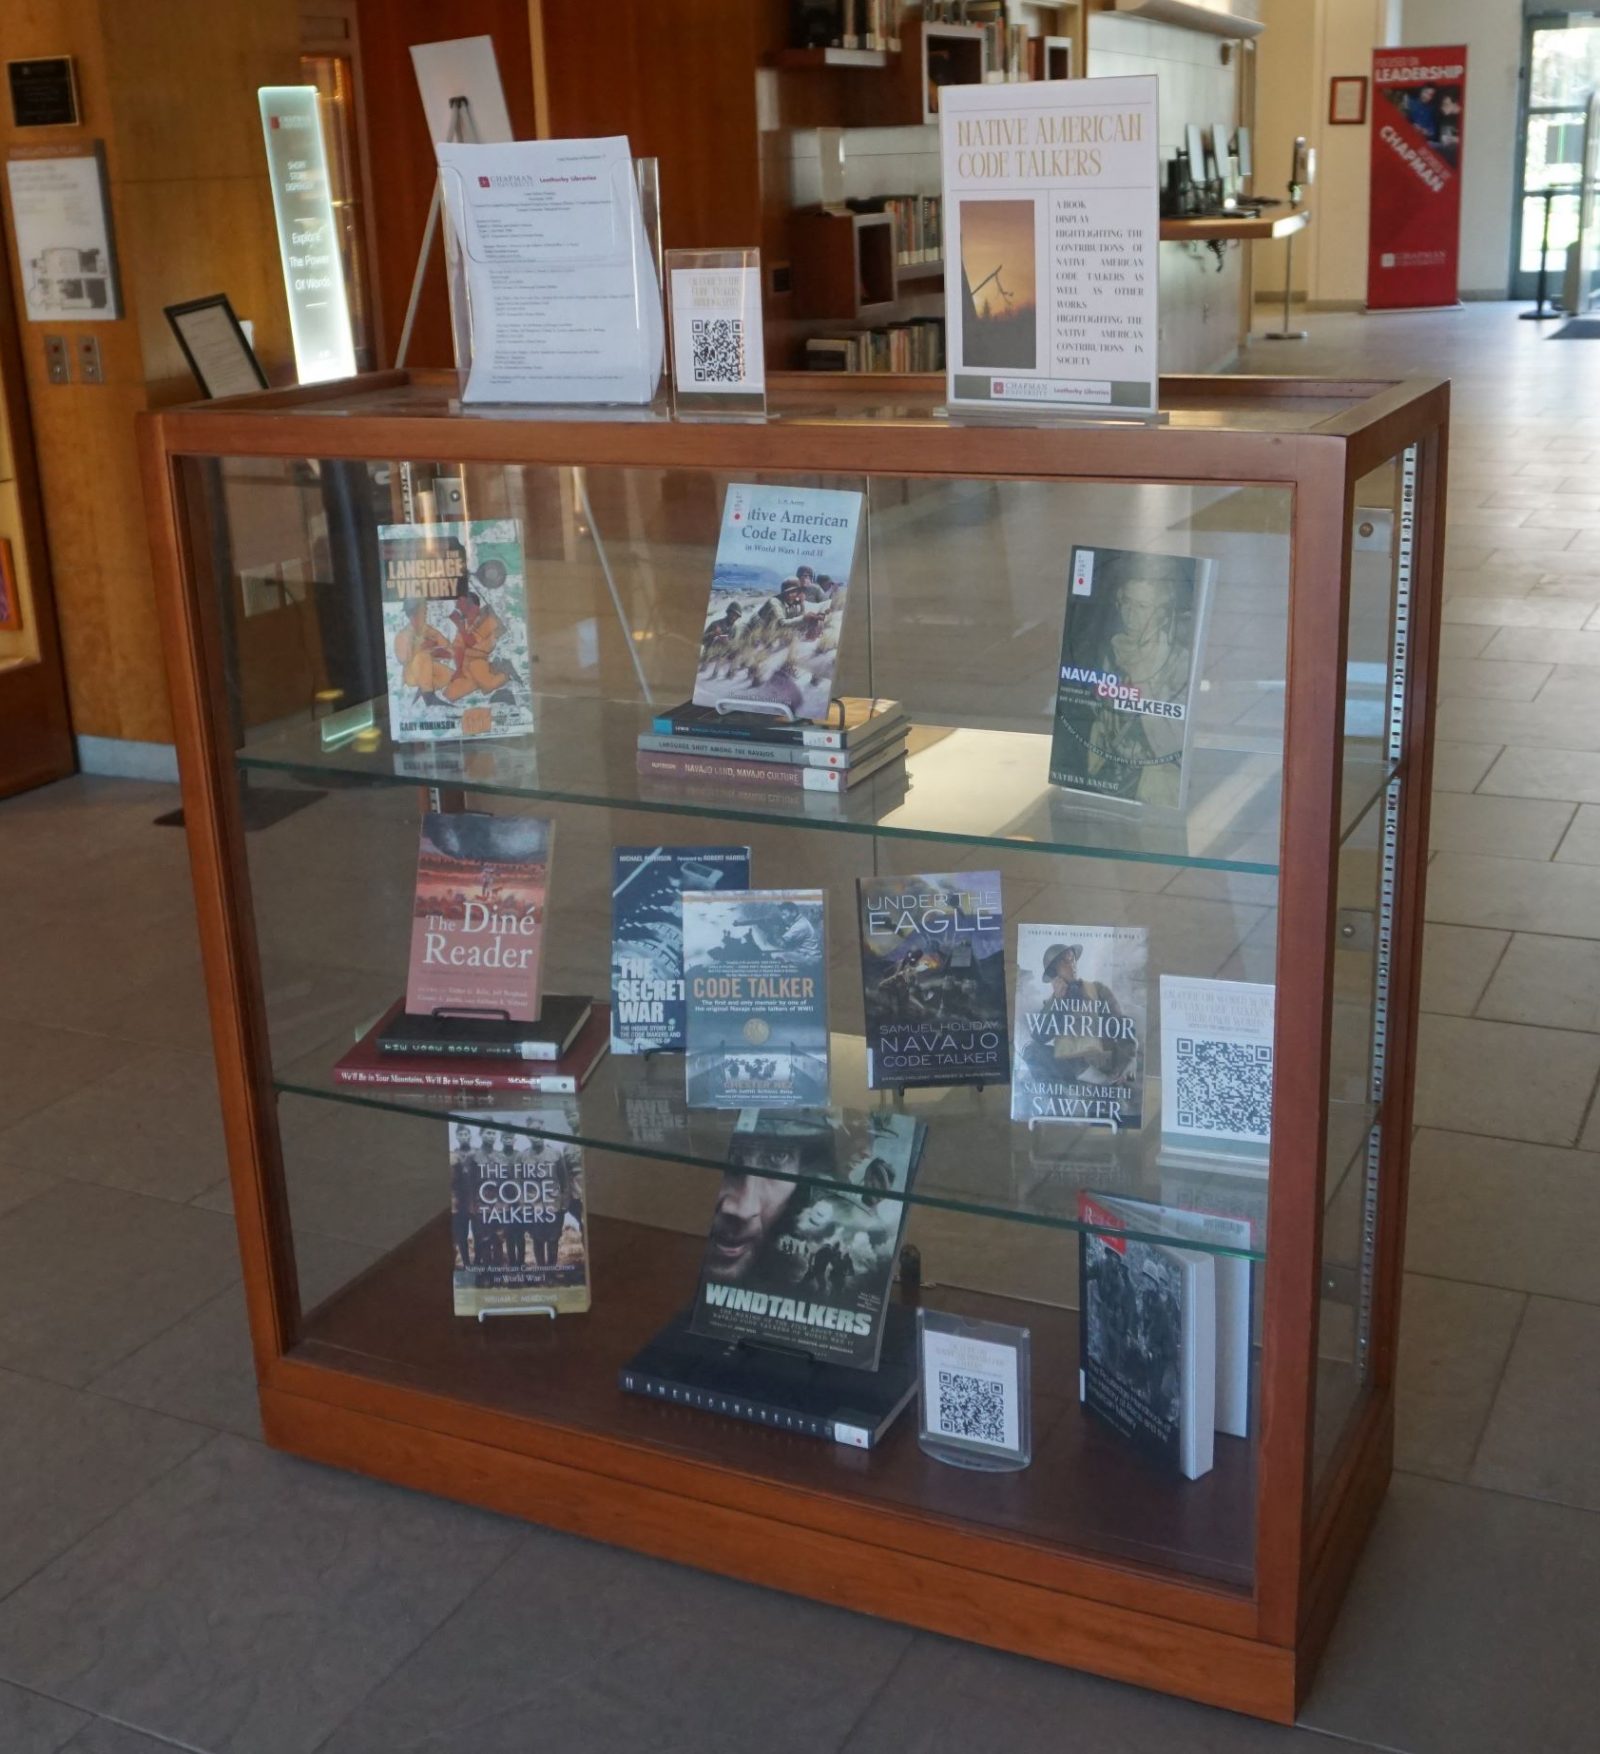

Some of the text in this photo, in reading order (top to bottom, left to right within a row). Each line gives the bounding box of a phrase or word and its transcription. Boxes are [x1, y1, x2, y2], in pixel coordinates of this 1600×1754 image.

[1375, 65, 1464, 82] LEADERSHIP
[958, 113, 1142, 146] NATIVE AMERICAN
[958, 149, 1103, 178] CODE TALKERS
[1380, 126, 1443, 192] CHAPMAN
[292, 232, 321, 246] Explore
[1128, 229, 1142, 238] THE
[1056, 243, 1143, 252] CONTRIBUTIONS OF
[289, 254, 330, 266] The Power
[1057, 258, 1144, 267] NATIVE AMERICAN
[295, 278, 331, 290] Of Words
[1056, 272, 1144, 281] CODE TALKERS AS
[1057, 286, 1144, 296] WELL AS OTHER
[1057, 300, 1087, 309] WORKS
[1128, 316, 1142, 325] THE
[1057, 329, 1144, 339] NATIVE AMERICAN
[1057, 343, 1125, 352] CONTRIBUTIONS
[1057, 356, 1090, 365] SOCIETY
[780, 510, 849, 529] American
[741, 525, 833, 546] Code Talkers
[754, 544, 776, 553] World
[801, 549, 816, 557] and
[389, 559, 463, 579] LANGUAGE
[397, 578, 458, 599] VICTORY
[1061, 666, 1117, 687] NAVAJO
[1098, 683, 1139, 701] CODE
[1116, 699, 1182, 718] TALKERS
[710, 745, 733, 754] AMONG
[747, 749, 775, 758] NAVAJOS
[685, 763, 713, 774] NAVAJO
[714, 766, 735, 777] LAND,
[736, 768, 766, 780] NAVAJO
[767, 770, 799, 782] CULTURE
[867, 892, 1001, 911] UNDER THE
[425, 902, 535, 935] The Diné
[869, 907, 1000, 935] EAGLE
[422, 933, 533, 969] Reader
[618, 980, 686, 1001] SECRET
[694, 978, 814, 998] CODE TALKER
[619, 1002, 664, 1023] WAR
[1051, 999, 1110, 1013] ANUMPA
[880, 1021, 999, 1035] SAMUEL HOLIDAY
[1026, 1013, 1136, 1040] WARRIOR
[881, 1033, 999, 1052] NAVAJO
[883, 1051, 998, 1068] CODE TALKER
[341, 1072, 358, 1081] We'll
[358, 1073, 367, 1081] Be
[368, 1073, 375, 1081] in
[375, 1073, 389, 1082] Your
[390, 1074, 424, 1084] Mountains,
[425, 1075, 442, 1085] We'll
[1024, 1082, 1131, 1099] SARAH ELISABETH
[1032, 1097, 1122, 1121] SAWYER
[478, 1163, 555, 1179] THE FIRST
[479, 1181, 554, 1204] CODE
[479, 1206, 556, 1224] TALKERS
[487, 1264, 519, 1272] American
[502, 1274, 525, 1282] World
[527, 1274, 542, 1282] War
[706, 1283, 872, 1337] WINDTALKERS
